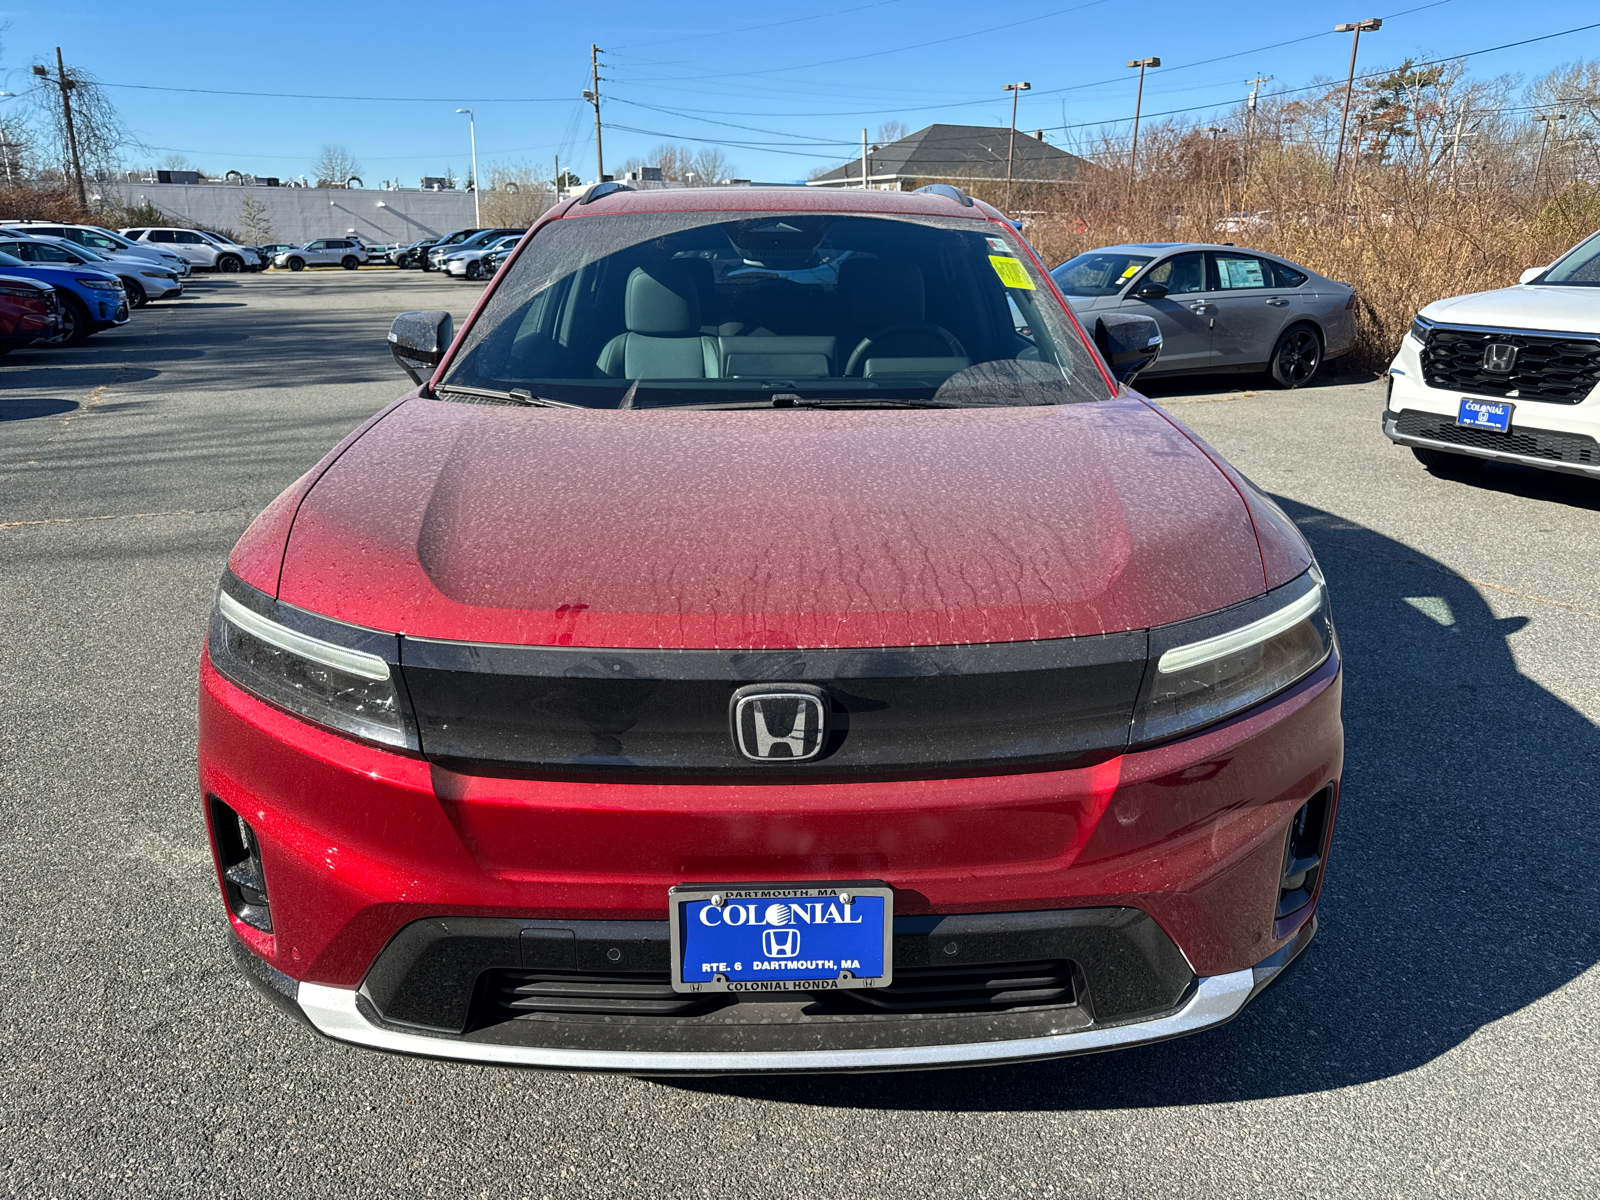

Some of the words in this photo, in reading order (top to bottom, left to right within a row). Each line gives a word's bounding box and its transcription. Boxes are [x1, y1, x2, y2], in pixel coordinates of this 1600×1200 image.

[1465, 401, 1505, 415] COLONIAL
[725, 890, 813, 898] DARTMOUTH,
[699, 902, 863, 927] COLONIAL
[702, 962, 731, 973] RTE.
[733, 961, 743, 971] 6
[752, 960, 838, 971] DARTMOUTH,
[840, 959, 861, 969] MA
[726, 980, 789, 991] COLONIAL
[793, 980, 839, 990] HONDA
